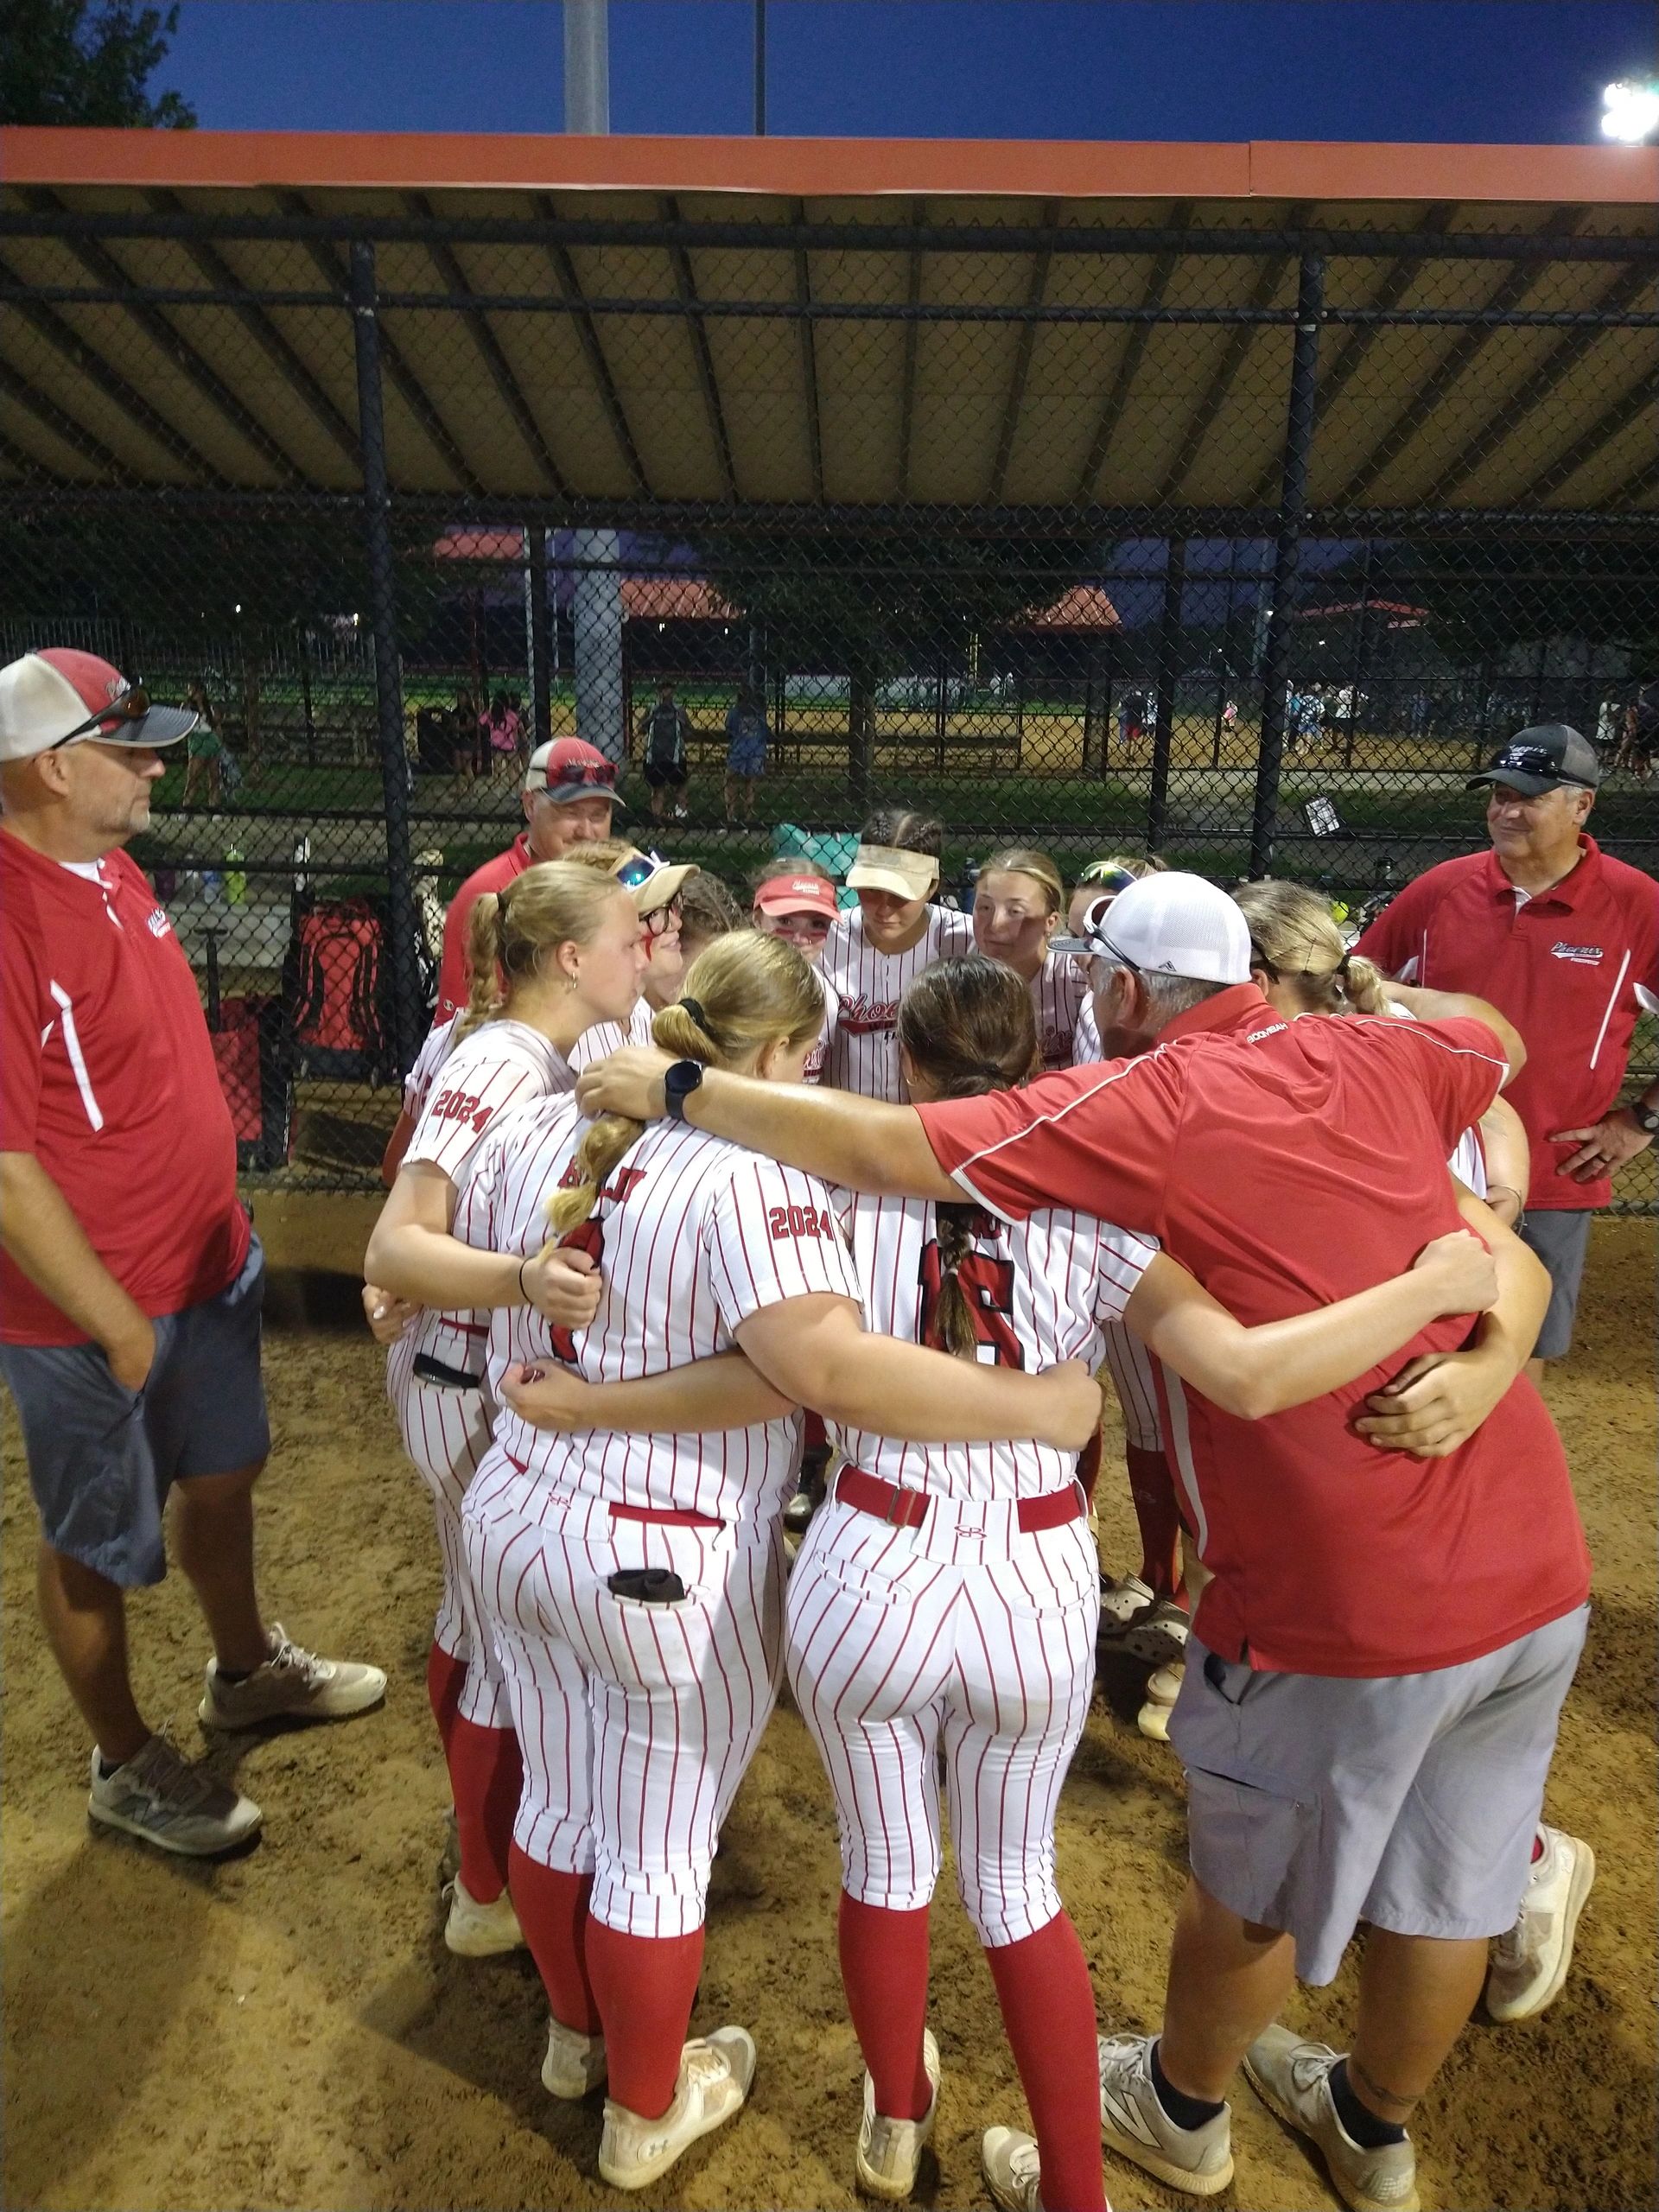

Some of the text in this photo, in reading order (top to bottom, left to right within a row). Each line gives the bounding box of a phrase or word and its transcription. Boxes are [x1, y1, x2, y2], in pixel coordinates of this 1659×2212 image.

[836, 993, 901, 1021] Phoe
[1246, 1022, 1288, 1044] BOOMBAH
[431, 1090, 493, 1134] 2024
[769, 1205, 835, 1242] 2024
